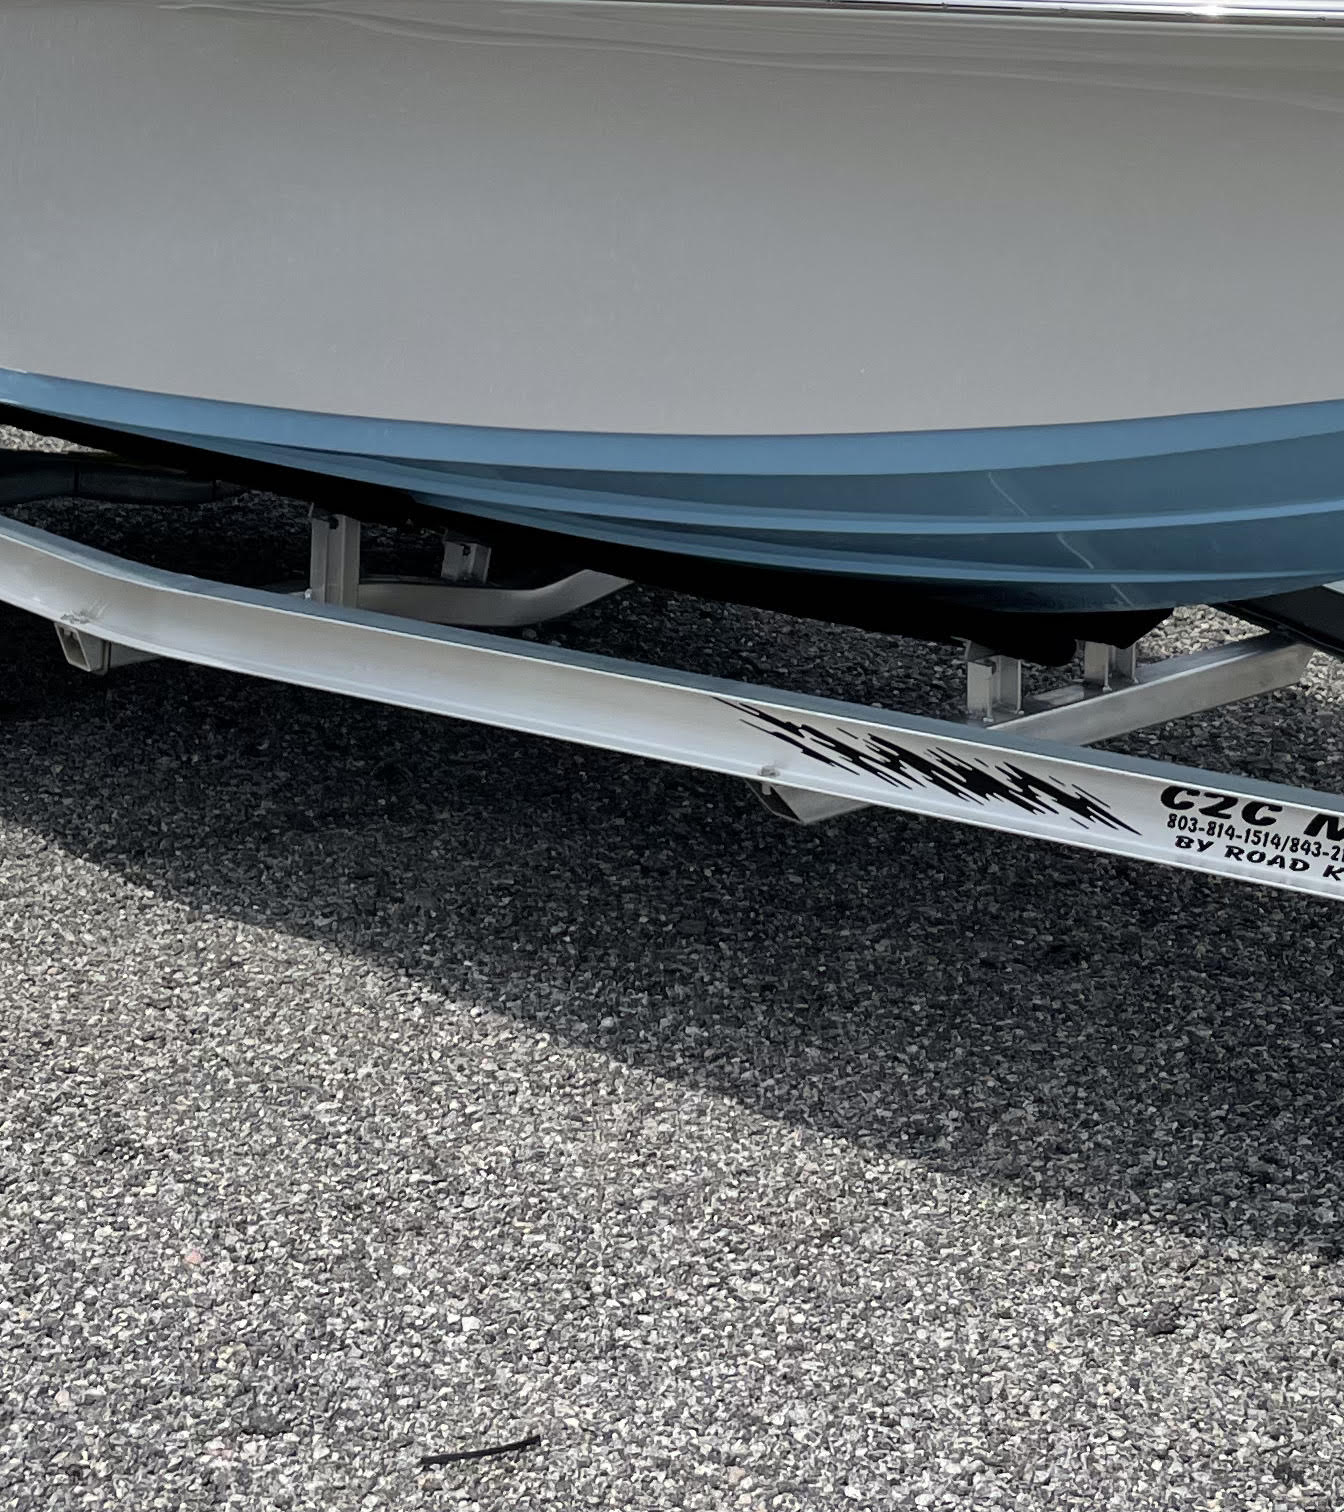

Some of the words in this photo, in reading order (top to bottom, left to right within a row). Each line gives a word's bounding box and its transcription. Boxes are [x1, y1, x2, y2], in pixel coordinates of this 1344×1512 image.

[1160, 785, 1283, 826] C2C
[1174, 835, 1214, 852] BY
[1224, 845, 1311, 871] ROAD
